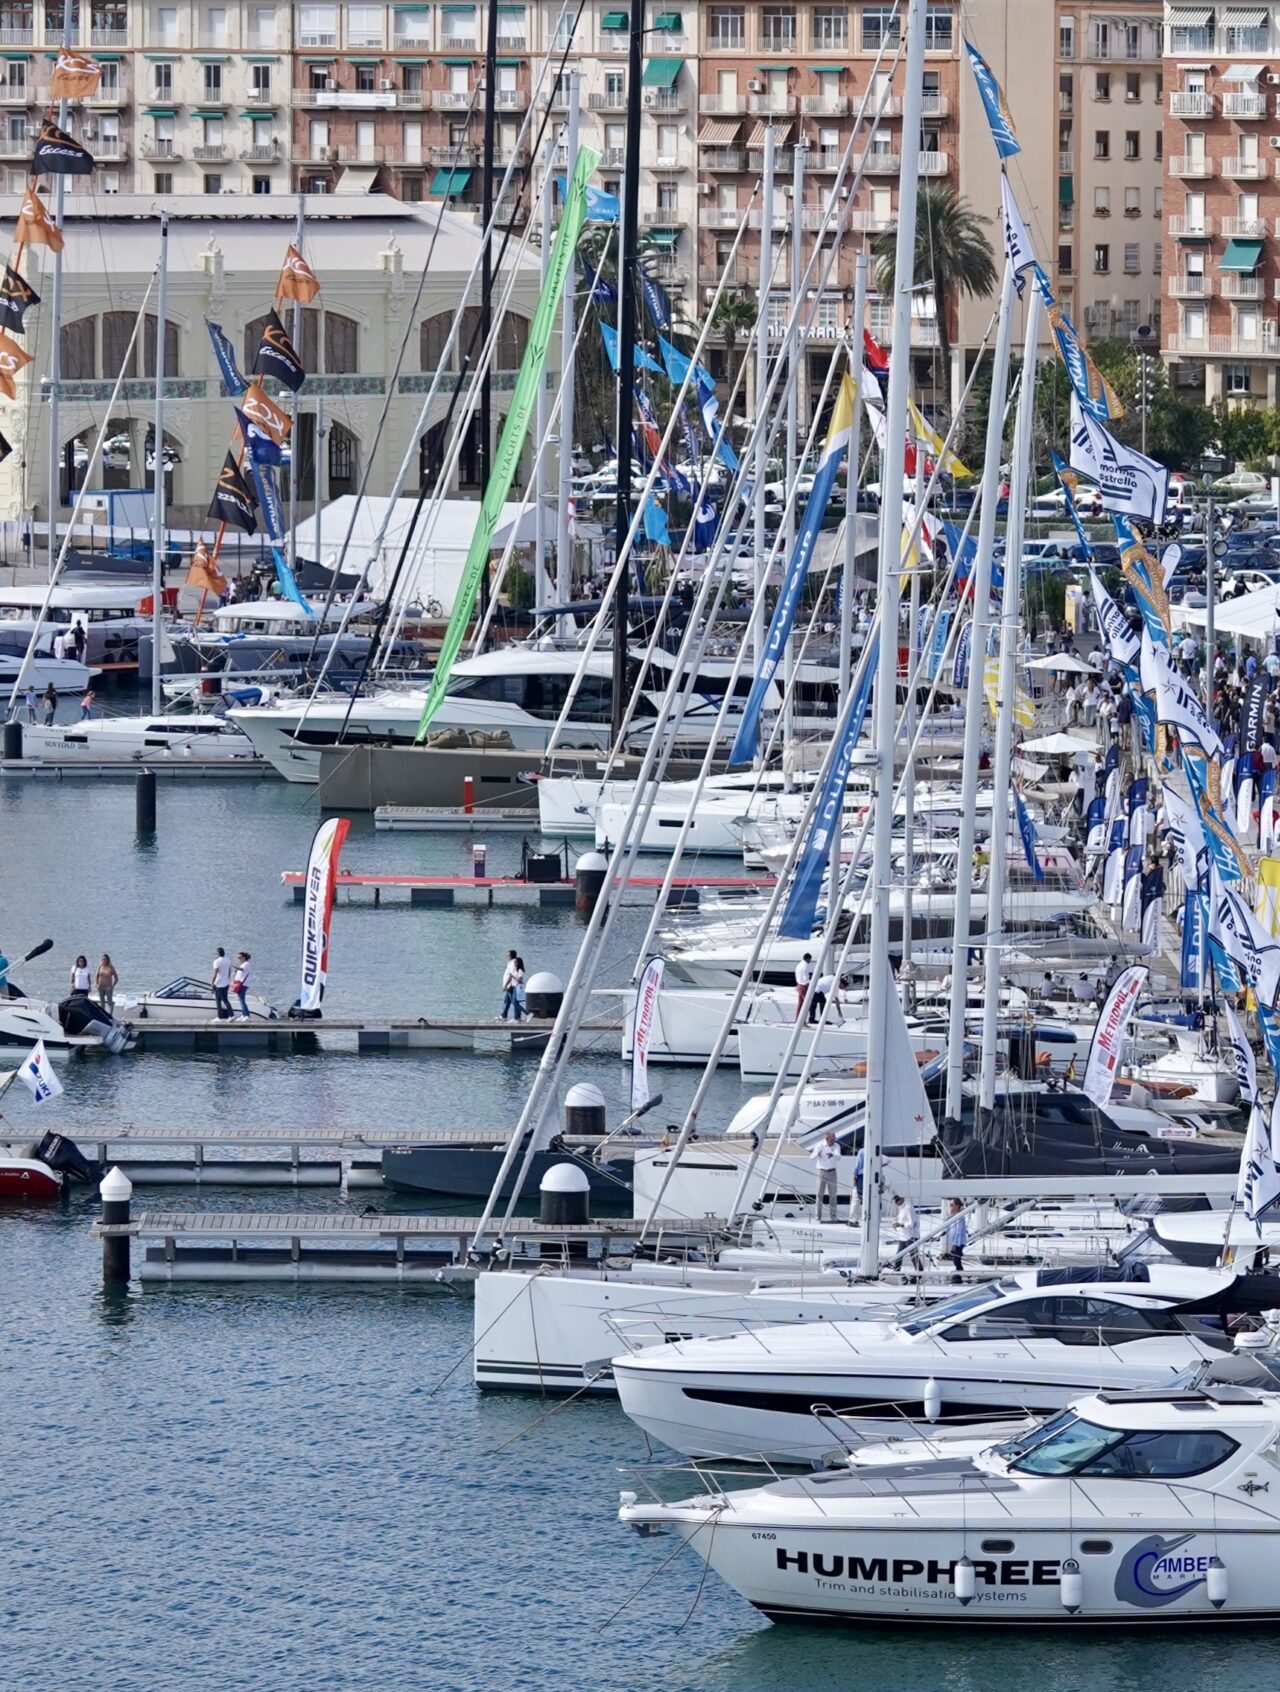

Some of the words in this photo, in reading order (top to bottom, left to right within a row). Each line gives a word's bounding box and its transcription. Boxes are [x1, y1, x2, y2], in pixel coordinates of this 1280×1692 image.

[499, 404, 528, 481] YYACHTS.DE
[1098, 473, 1138, 488] estrella
[1100, 463, 1136, 478] marina
[303, 867, 322, 986] QUICKSILVER
[637, 984, 655, 1048] METROPOL
[1097, 988, 1129, 1053] METROPOL
[751, 1532, 777, 1541] 67450
[813, 1578, 847, 1592] Trim
[849, 1583, 876, 1595] and
